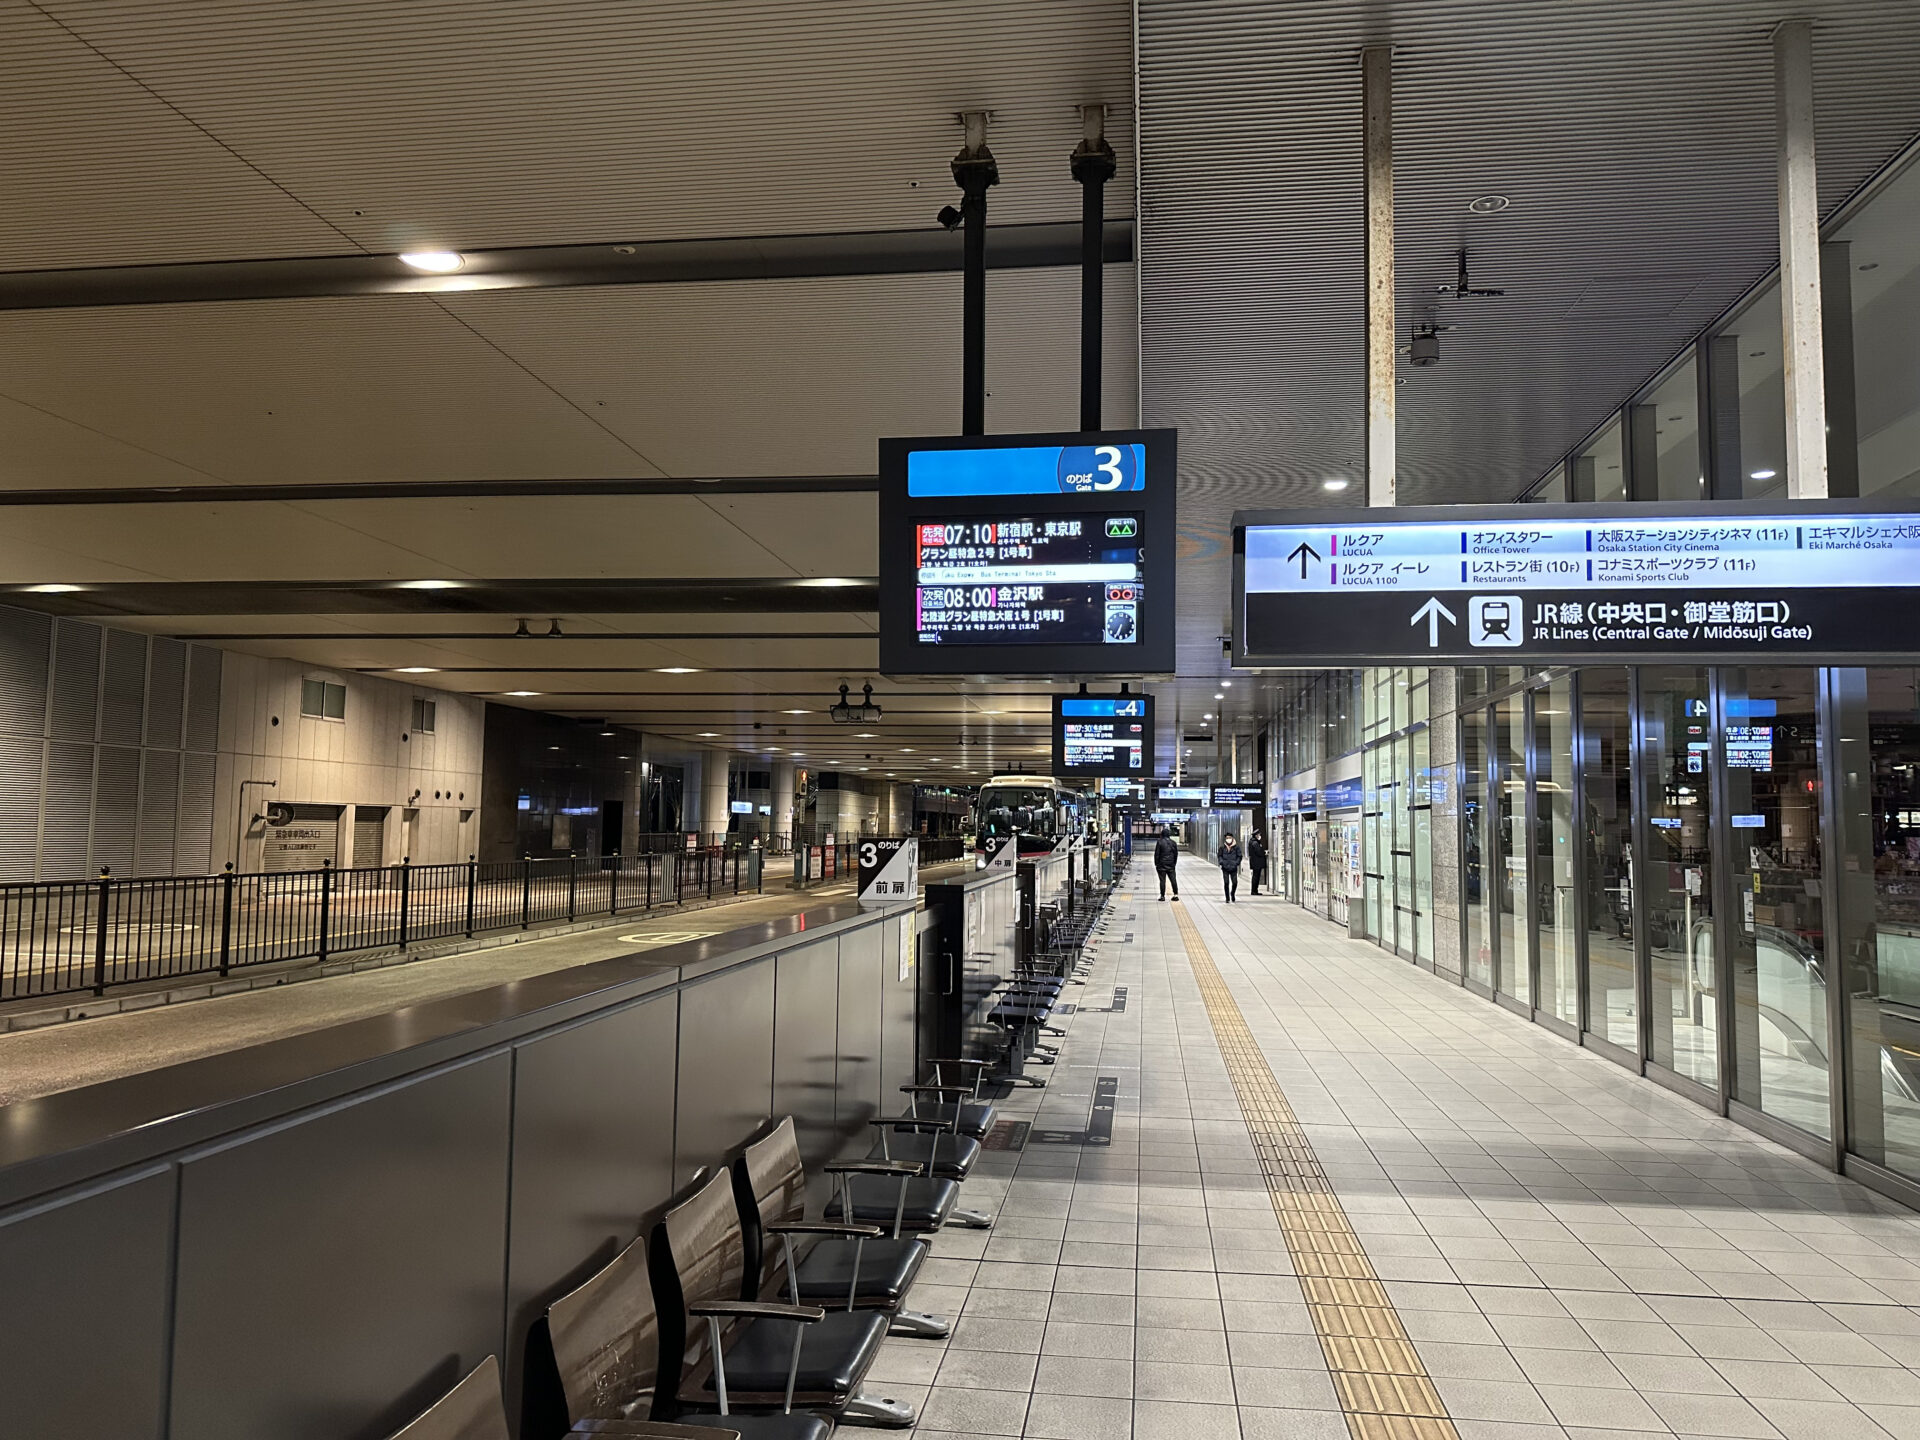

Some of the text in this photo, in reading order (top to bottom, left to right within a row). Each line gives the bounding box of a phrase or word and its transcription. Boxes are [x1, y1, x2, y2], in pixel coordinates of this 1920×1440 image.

[1094, 446, 1123, 491] 3
[1066, 473, 1093, 484] のりば
[922, 521, 1082, 545] 先発 07:10 新宿駅・東京駅
[1473, 531, 1553, 544] オフィスタワー
[1598, 528, 1788, 543] 大阪ステーションシティシネマ (11F)
[1808, 525, 1920, 540] エキマルシェ大阪
[1343, 534, 1384, 547] ルクア
[1809, 540, 1893, 550] Eki Marché Osaka
[1342, 549, 1373, 557] LUCUA
[1473, 546, 1531, 555] Office Tower
[1598, 543, 1720, 554] Osaka Station City Cinema
[1343, 562, 1430, 575] ルクア イーレ
[1473, 560, 1580, 574] レストラン街 (10F)
[1598, 557, 1756, 572] コナミスポーツクラブ (11F)
[1342, 576, 1398, 586] LUCUA 1100
[1473, 575, 1527, 584] Restaurants
[1598, 572, 1690, 583] Konami Sports Club
[923, 586, 1044, 608] 次発 08:00 金沢駅
[1532, 628, 1549, 640] JR
[1552, 627, 1589, 640] Lines
[1592, 626, 1650, 642] (Central
[1653, 626, 1689, 640] Gate
[1770, 624, 1813, 642] Gate)
[1125, 700, 1138, 717] 4
[878, 841, 900, 850] のりば
[985, 837, 996, 853] 3
[859, 842, 878, 868] 3
[875, 880, 905, 895] 前扉
